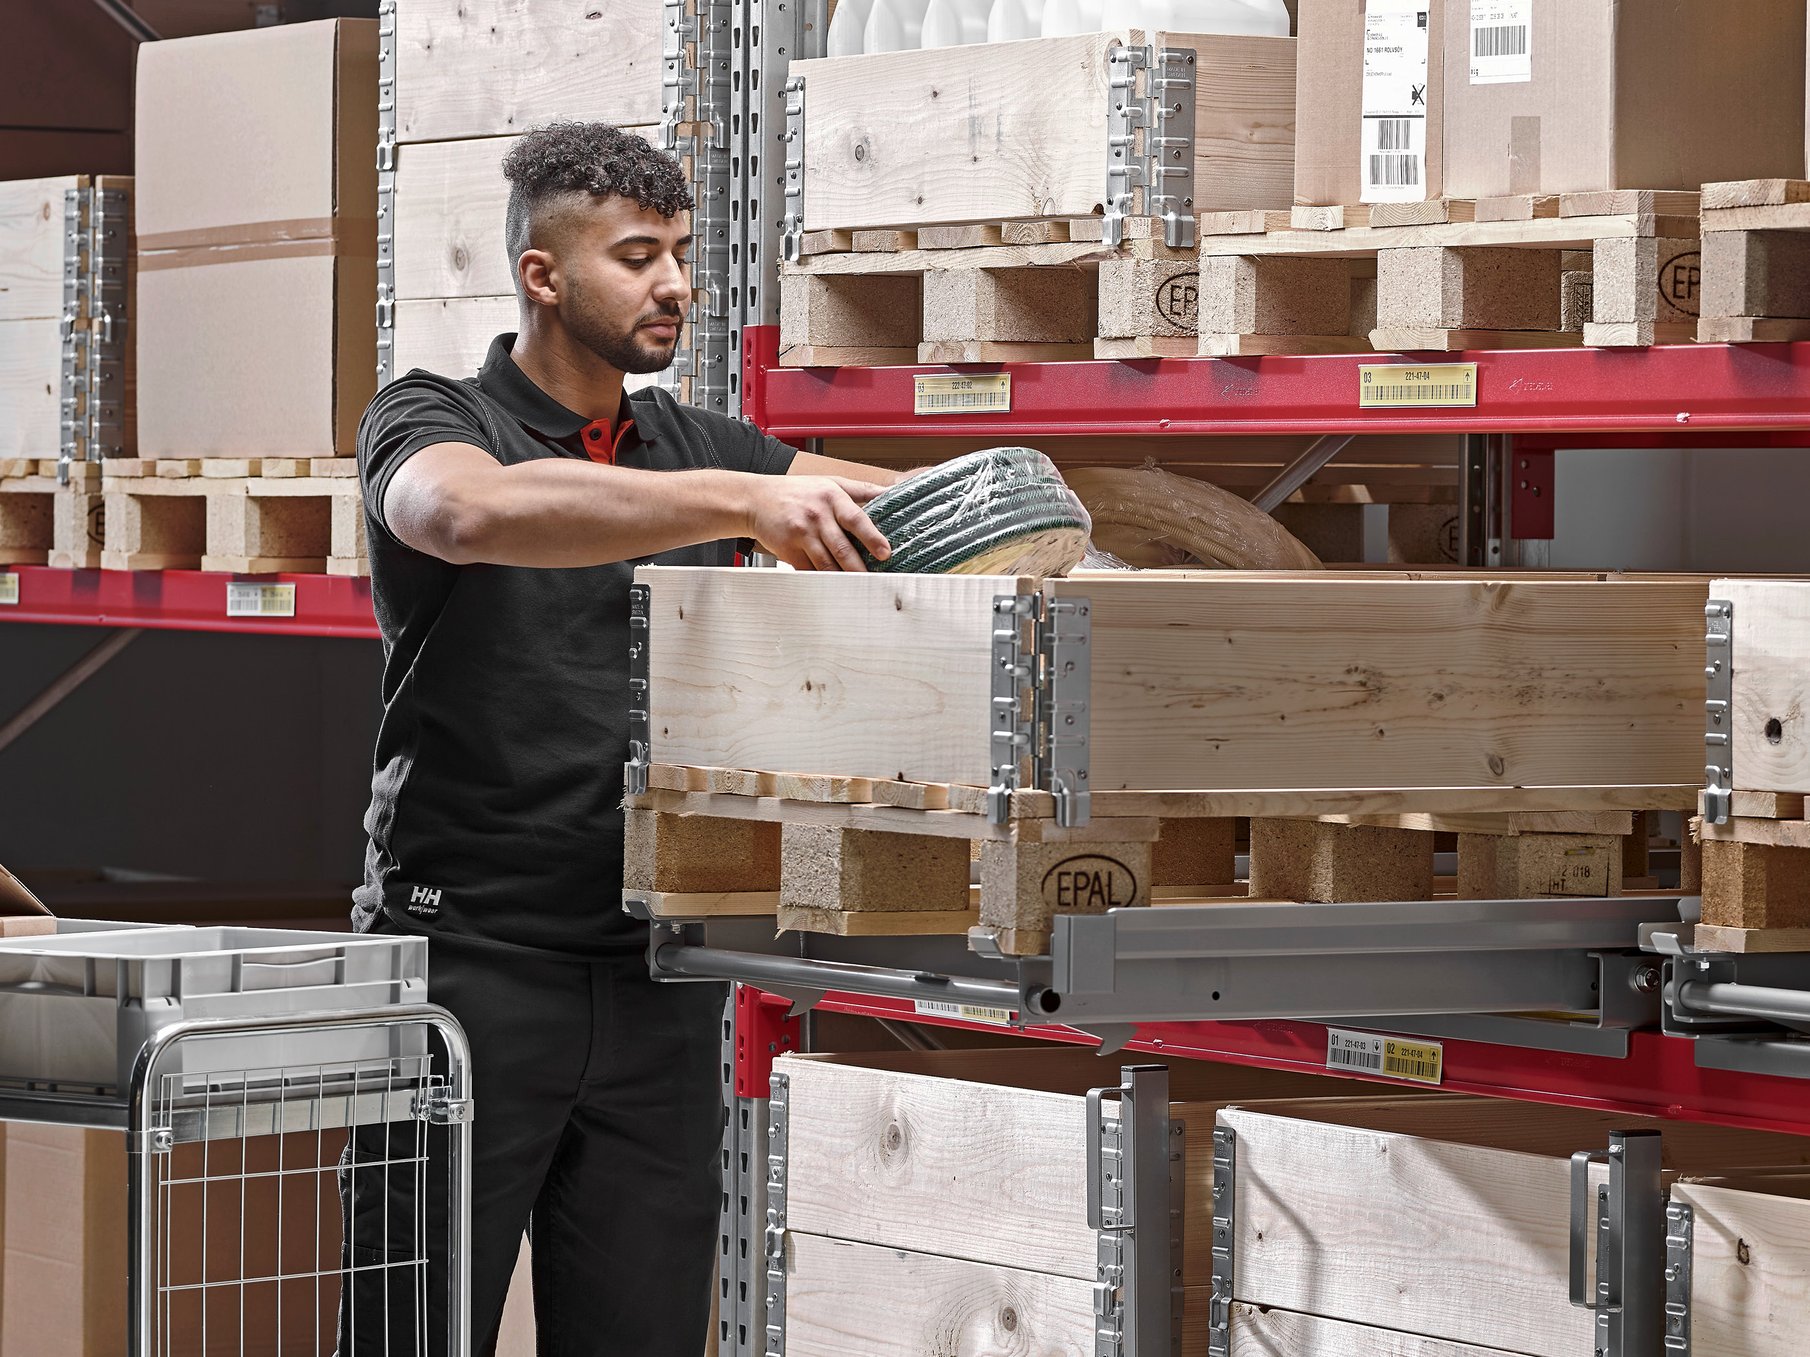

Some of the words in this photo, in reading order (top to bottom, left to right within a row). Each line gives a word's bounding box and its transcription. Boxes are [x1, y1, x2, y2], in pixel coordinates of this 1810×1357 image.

[1363, 371, 1372, 383] 03
[1405, 371, 1430, 381] 221-47-04
[1057, 871, 1122, 906] EPAL
[1331, 1033, 1339, 1046] 01
[1386, 1042, 1395, 1055] 02
